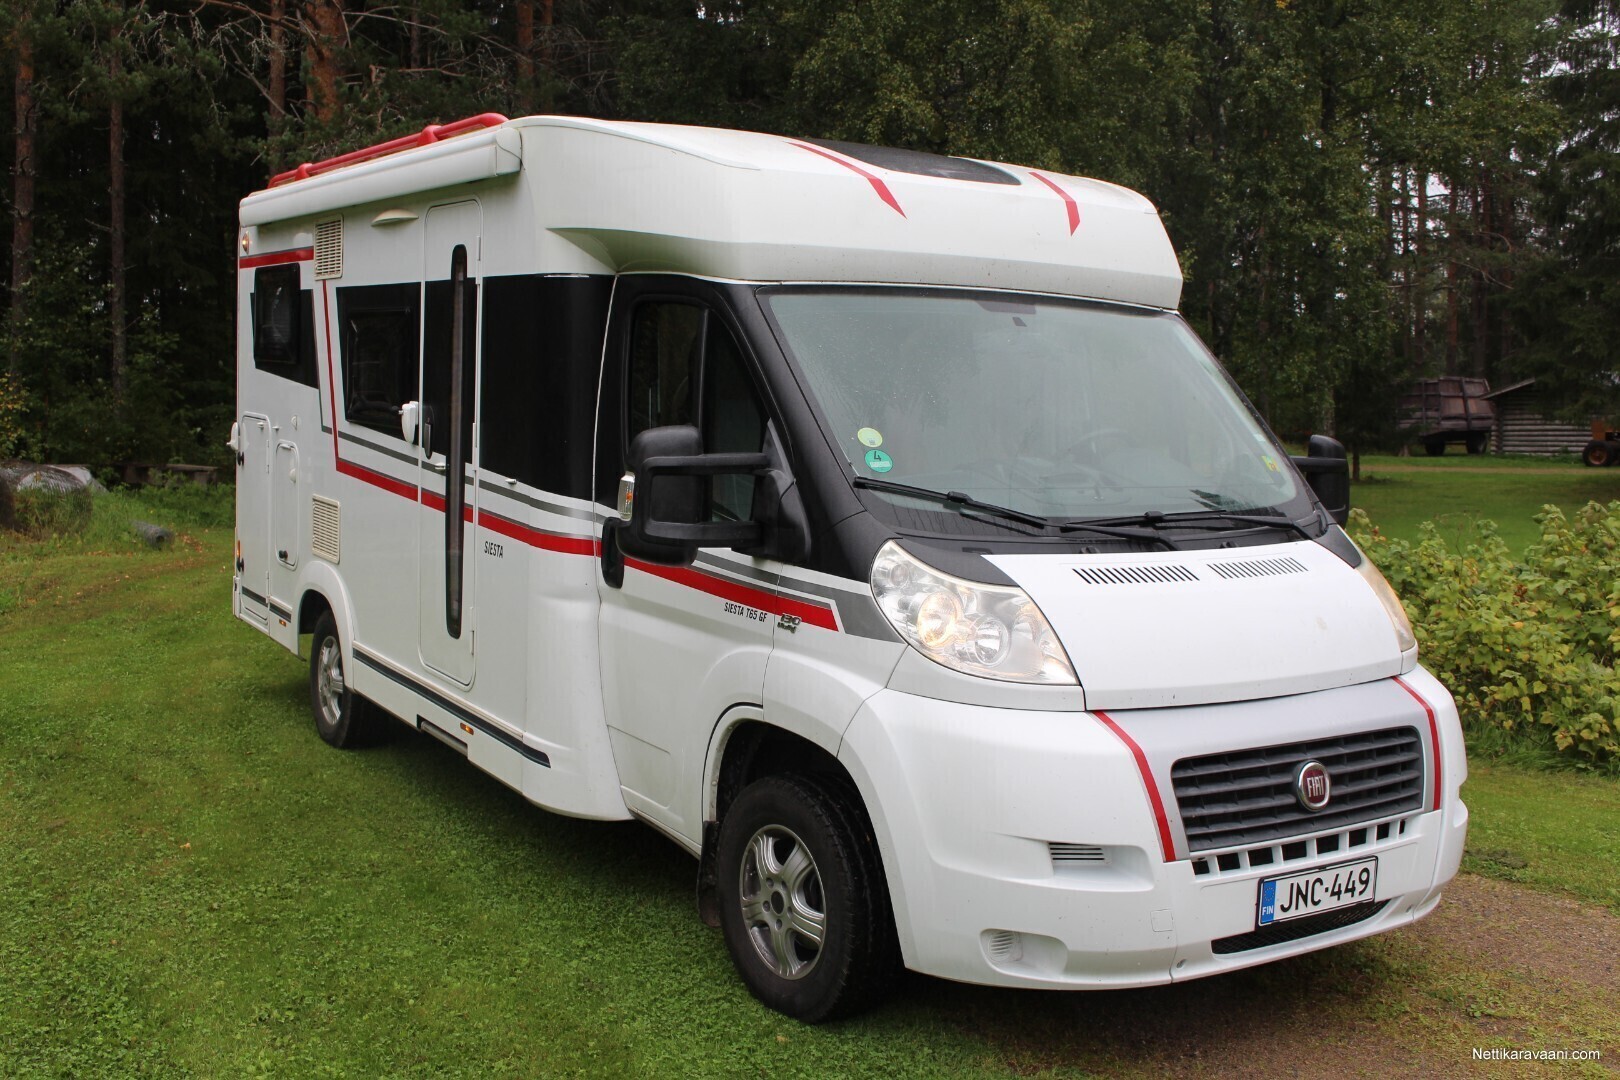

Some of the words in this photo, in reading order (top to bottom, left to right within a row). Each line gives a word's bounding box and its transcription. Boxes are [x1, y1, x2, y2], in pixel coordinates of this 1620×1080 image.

[484, 541, 504, 559] SIESTA
[724, 602, 745, 616] SIESTA
[746, 608, 757, 620] T65
[758, 612, 768, 623] GF
[1307, 776, 1324, 798] FIAT
[1280, 867, 1370, 912] JNC-449
[1262, 905, 1274, 915] FIN
